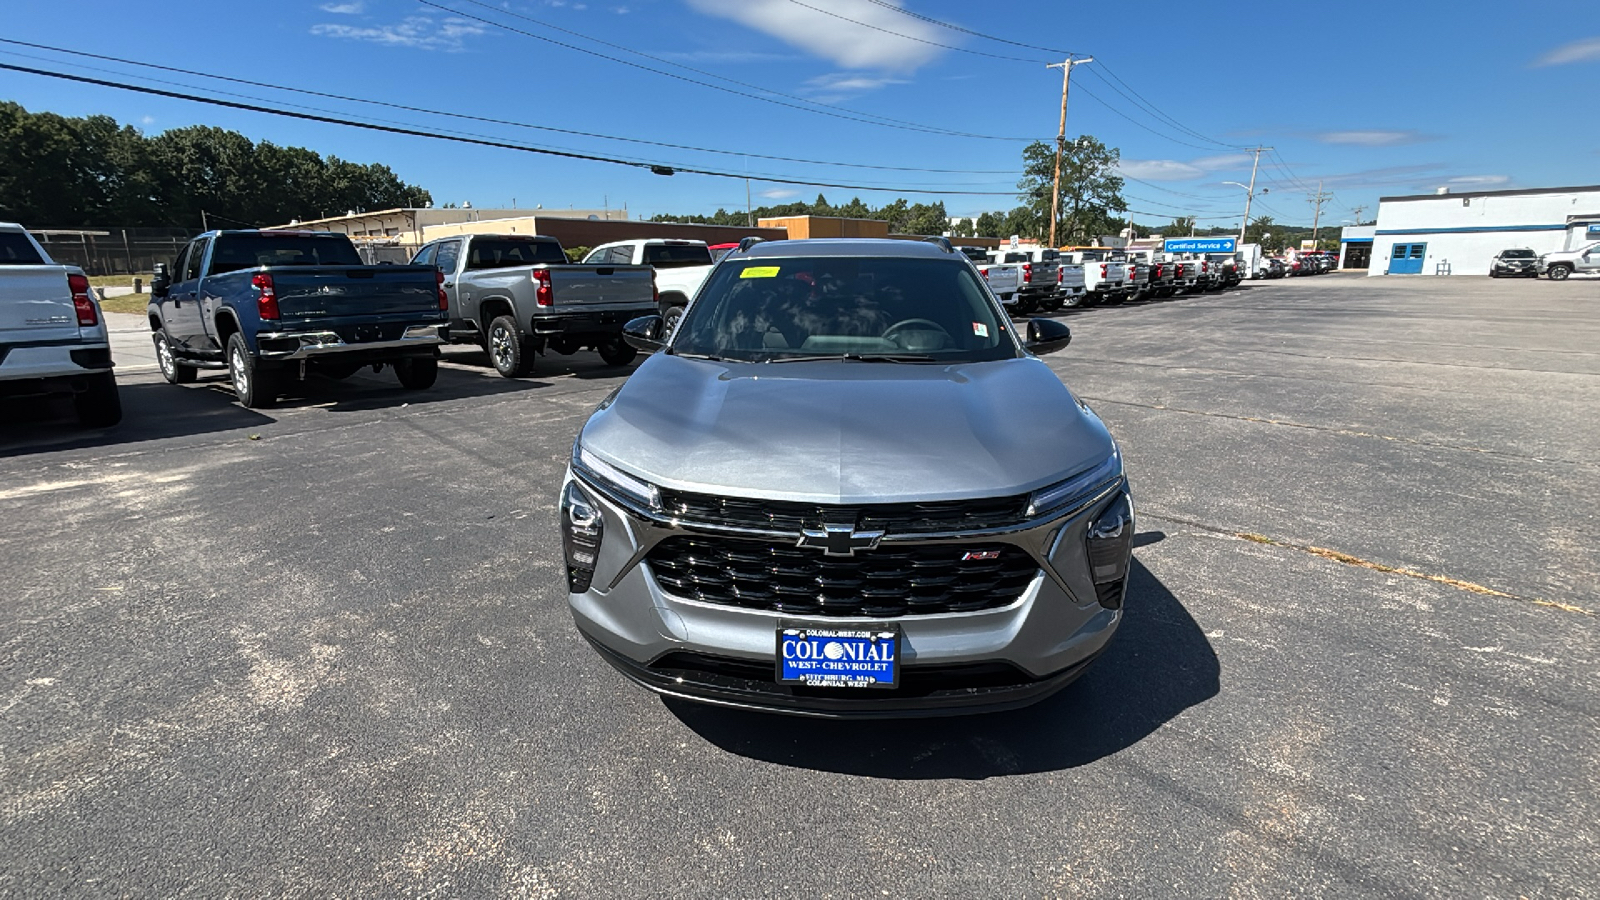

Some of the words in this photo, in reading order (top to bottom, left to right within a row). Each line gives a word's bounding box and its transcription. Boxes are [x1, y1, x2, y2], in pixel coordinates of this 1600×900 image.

[806, 629, 871, 638] COLONIAL-WEST.COM
[782, 640, 894, 661] COLONIAL
[822, 661, 888, 671] CHEVROLET
